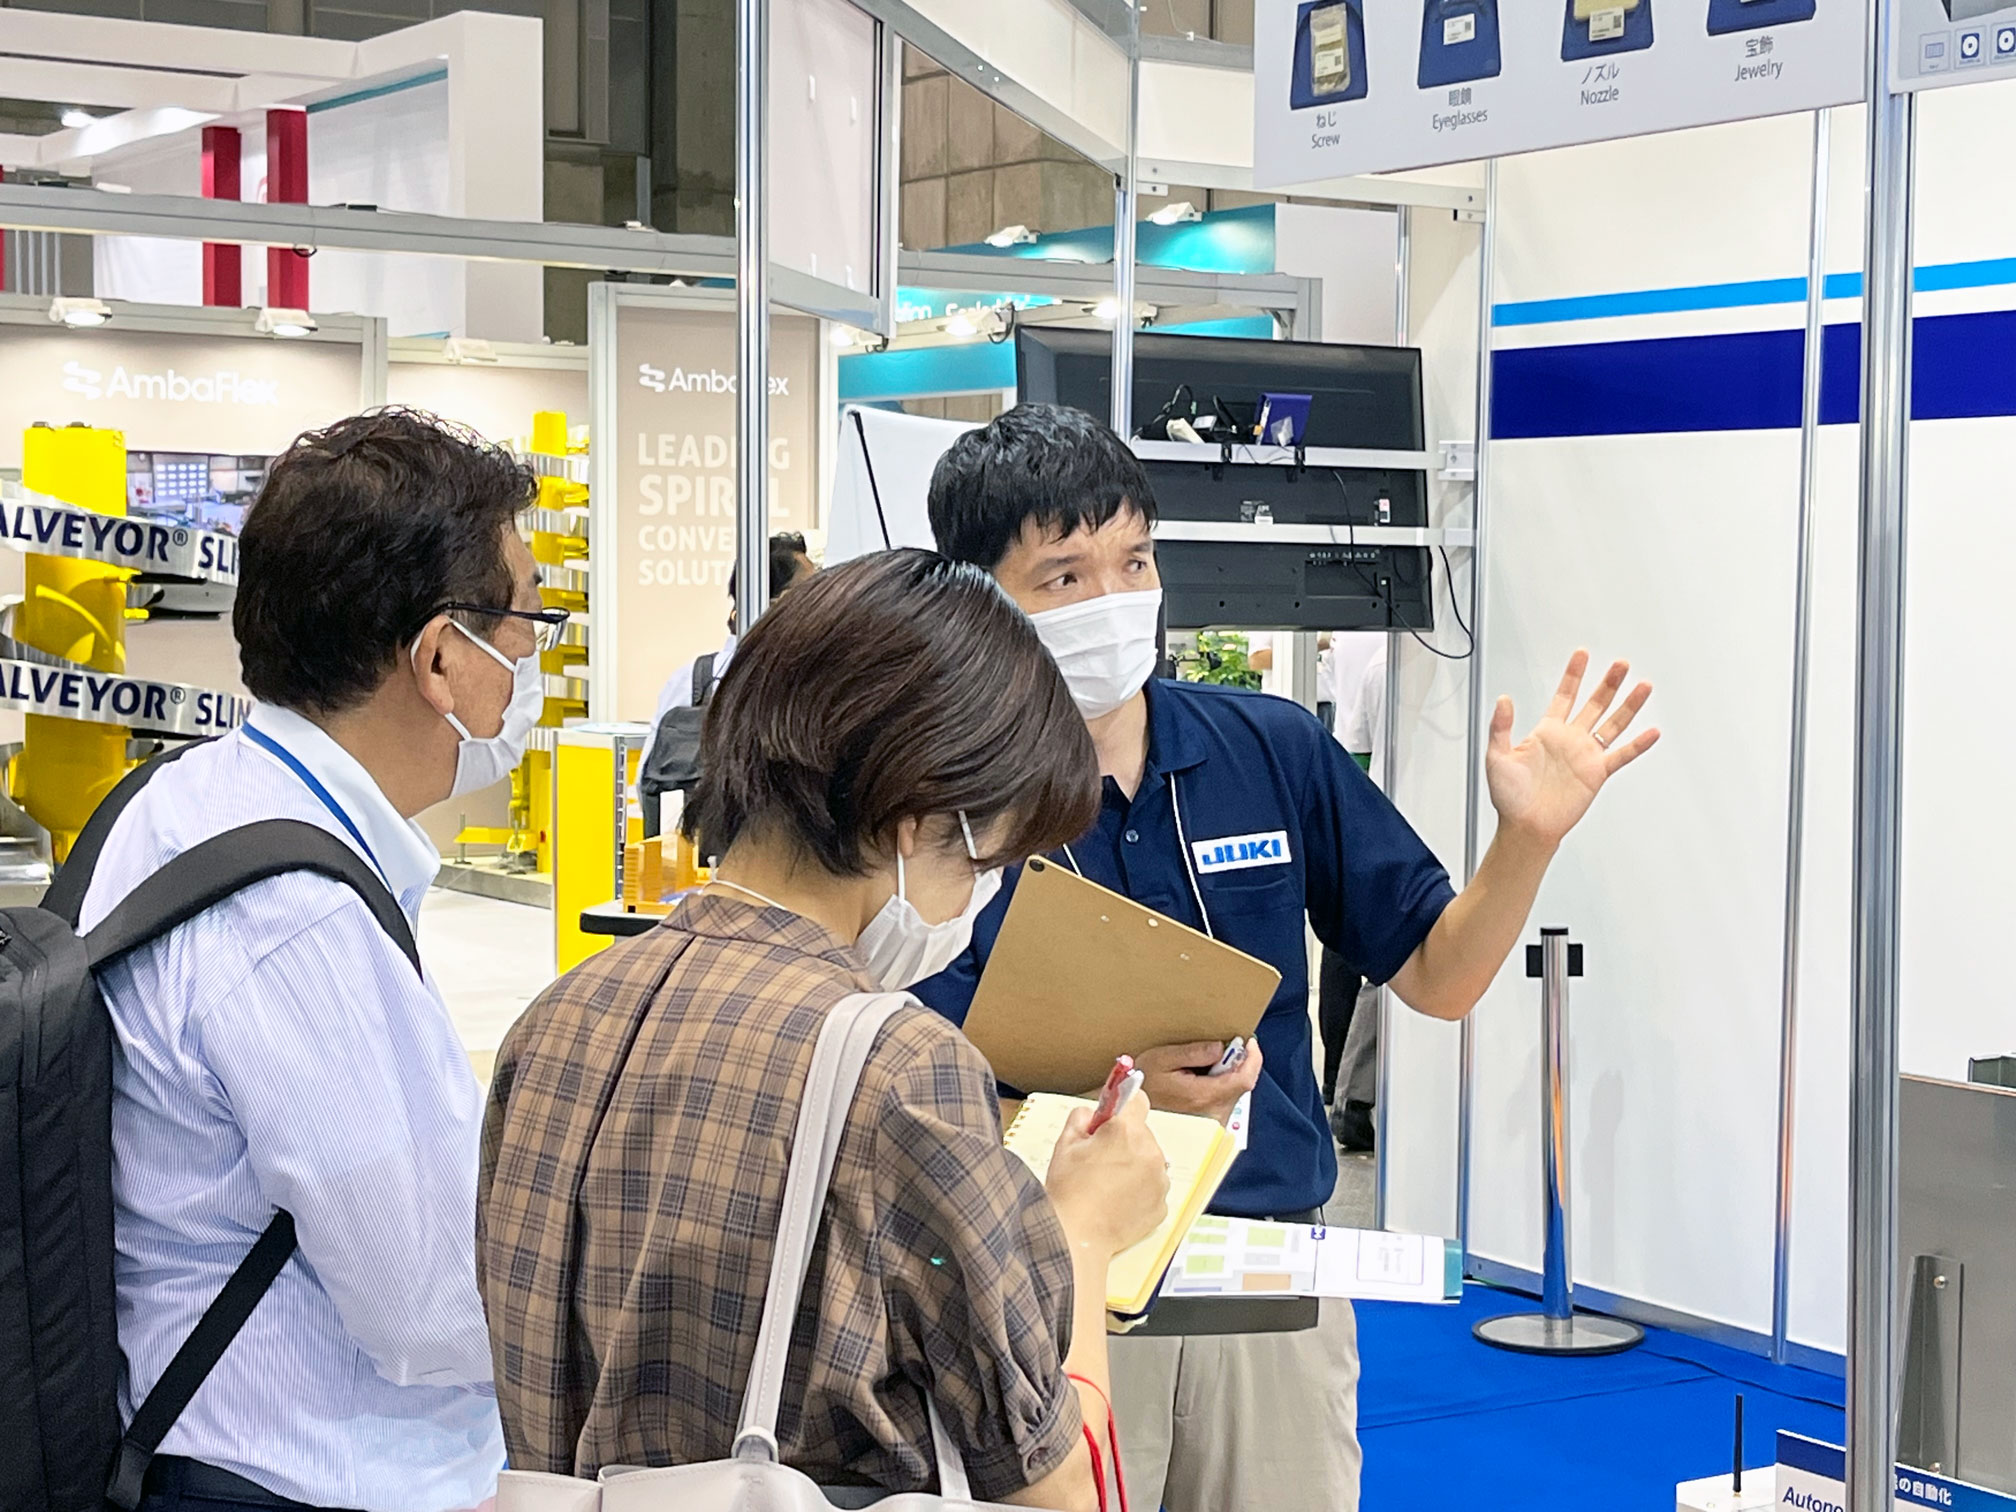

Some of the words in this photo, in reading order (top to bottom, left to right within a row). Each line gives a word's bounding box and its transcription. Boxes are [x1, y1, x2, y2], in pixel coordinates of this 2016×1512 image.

[1581, 62, 1620, 84] ノズル
[1734, 59, 1783, 82] Jewelry
[1580, 85, 1620, 105] Nozzle
[1316, 111, 1337, 129] ねじ
[1432, 110, 1488, 132] Eyeglasses
[1312, 133, 1340, 149] Screw
[105, 366, 280, 406] AmbaFlex
[638, 433, 790, 470] LEADIG
[638, 474, 790, 518] SPIRL
[638, 525, 736, 552] CONVE
[1202, 839, 1281, 865] JUKI
